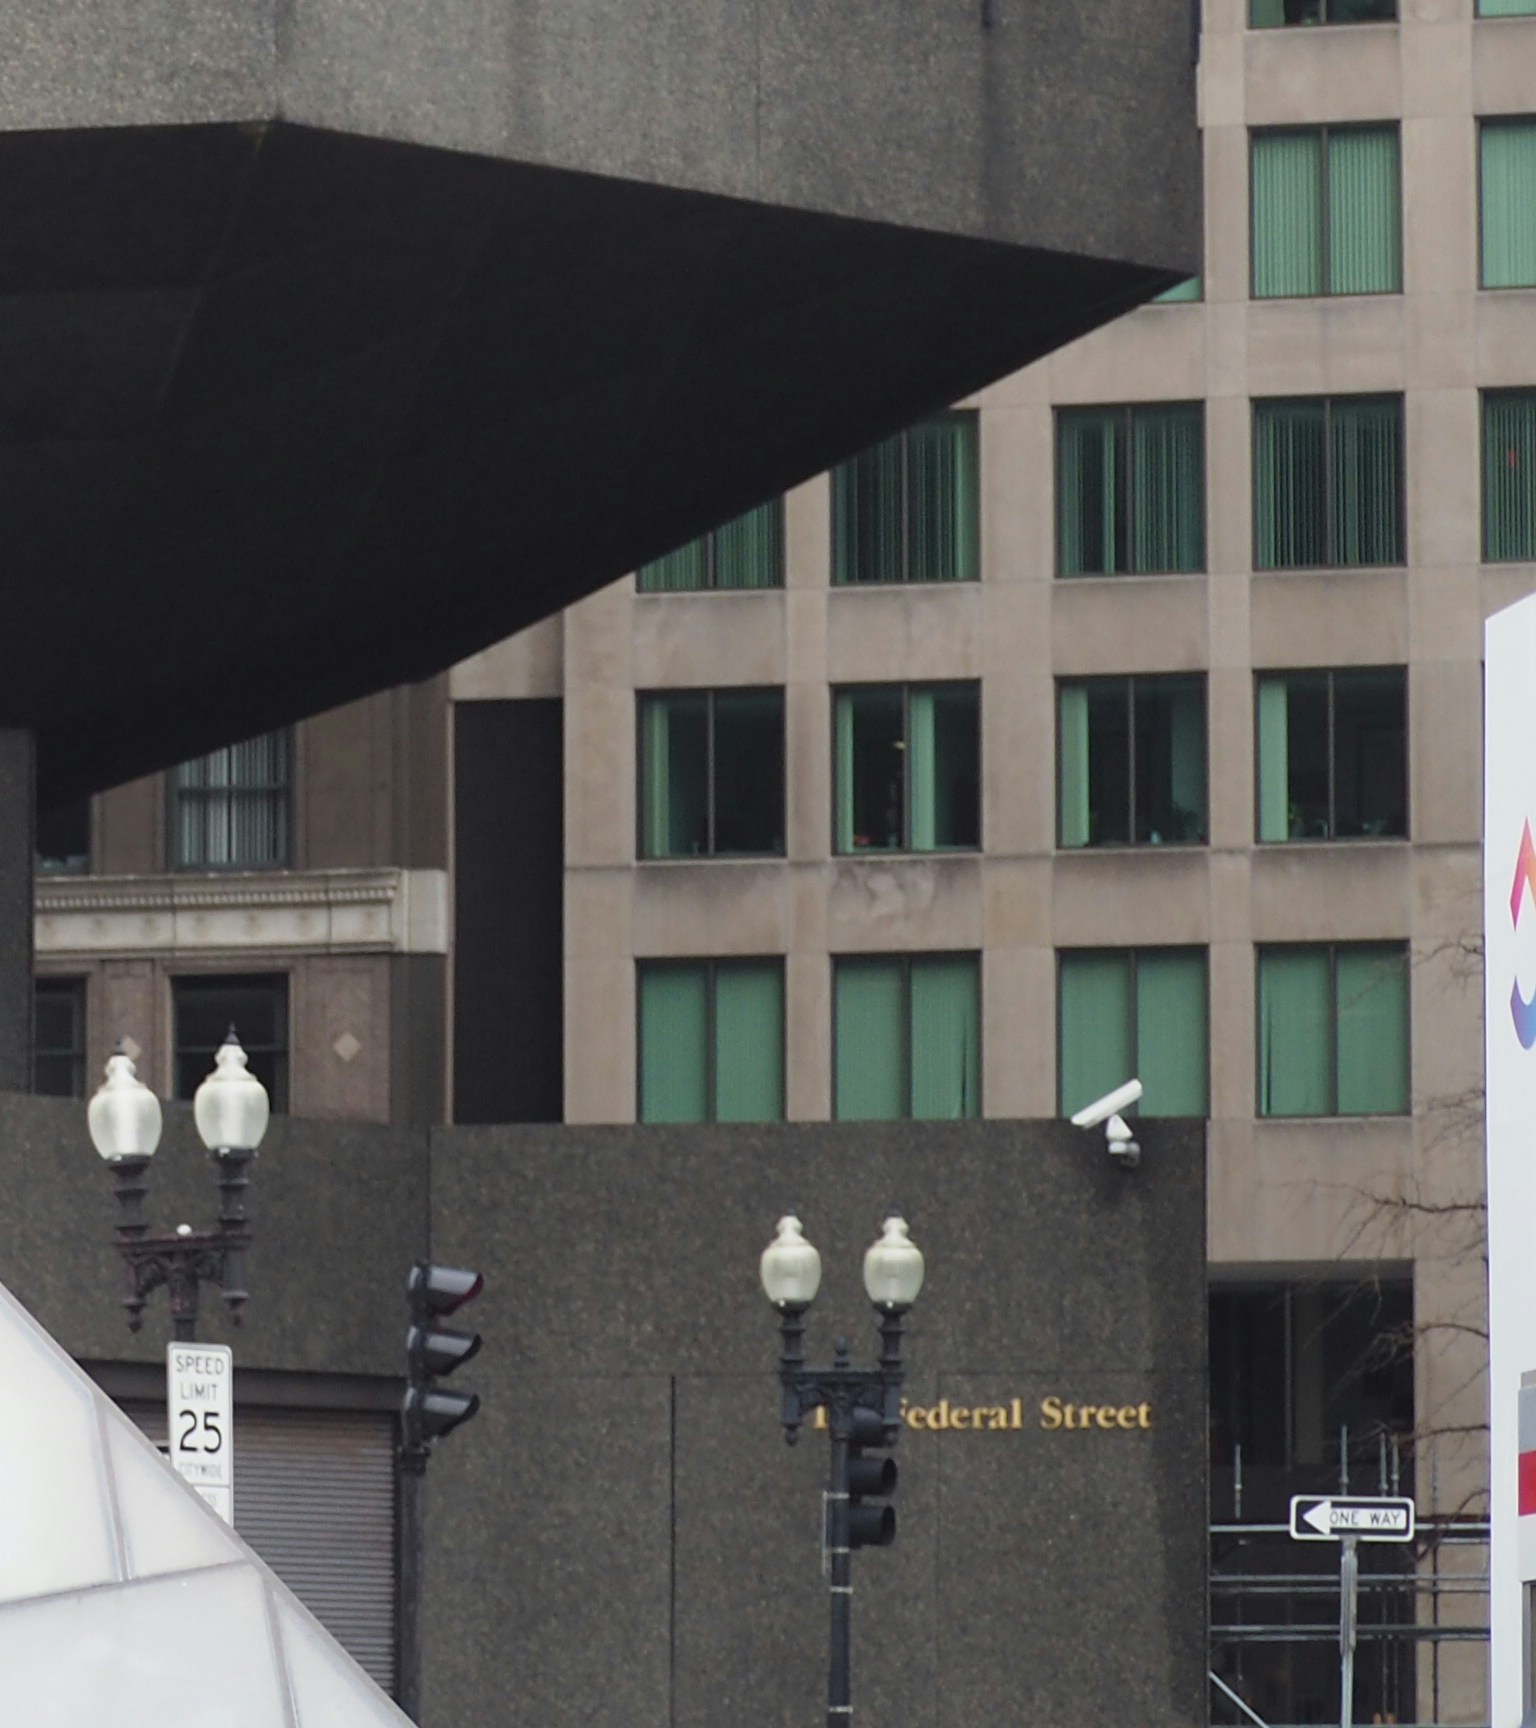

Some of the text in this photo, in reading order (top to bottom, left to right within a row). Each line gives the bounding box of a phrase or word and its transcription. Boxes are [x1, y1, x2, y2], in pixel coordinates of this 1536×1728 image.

[176, 1355, 225, 1375] SPEED
[180, 1382, 218, 1402] LIMIT
[1040, 1395, 1152, 1430] Street
[179, 1409, 222, 1454] 25
[1329, 1510, 1400, 1525] ONE WAY
